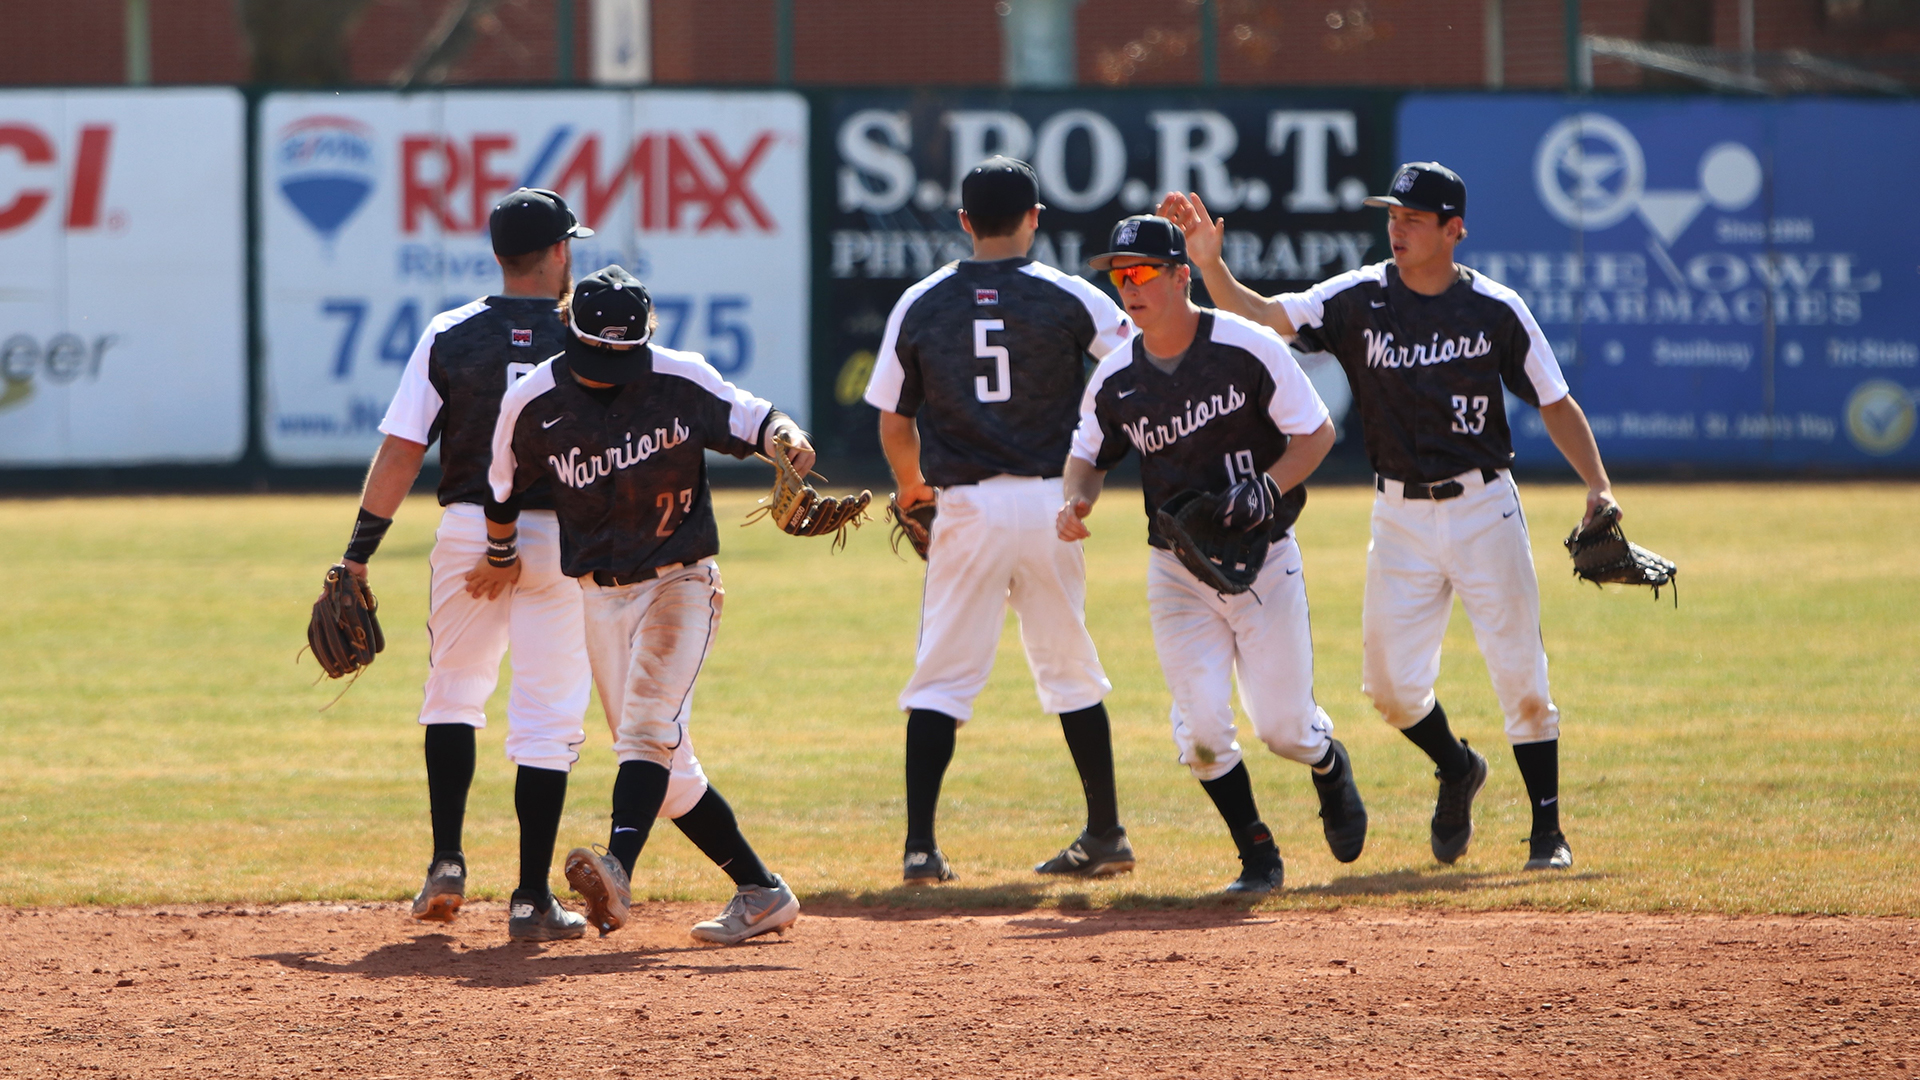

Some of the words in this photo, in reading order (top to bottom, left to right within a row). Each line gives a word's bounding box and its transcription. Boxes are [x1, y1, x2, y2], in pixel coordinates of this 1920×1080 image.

[398, 126, 780, 236] RE/MAX
[1688, 252, 1882, 293] OWL
[973, 319, 1011, 403] 5
[1364, 328, 1492, 369] Warriors
[1123, 384, 1246, 456] Warriors
[1451, 395, 1489, 436] 33
[549, 417, 690, 489] Warriors
[1224, 449, 1257, 485] 19
